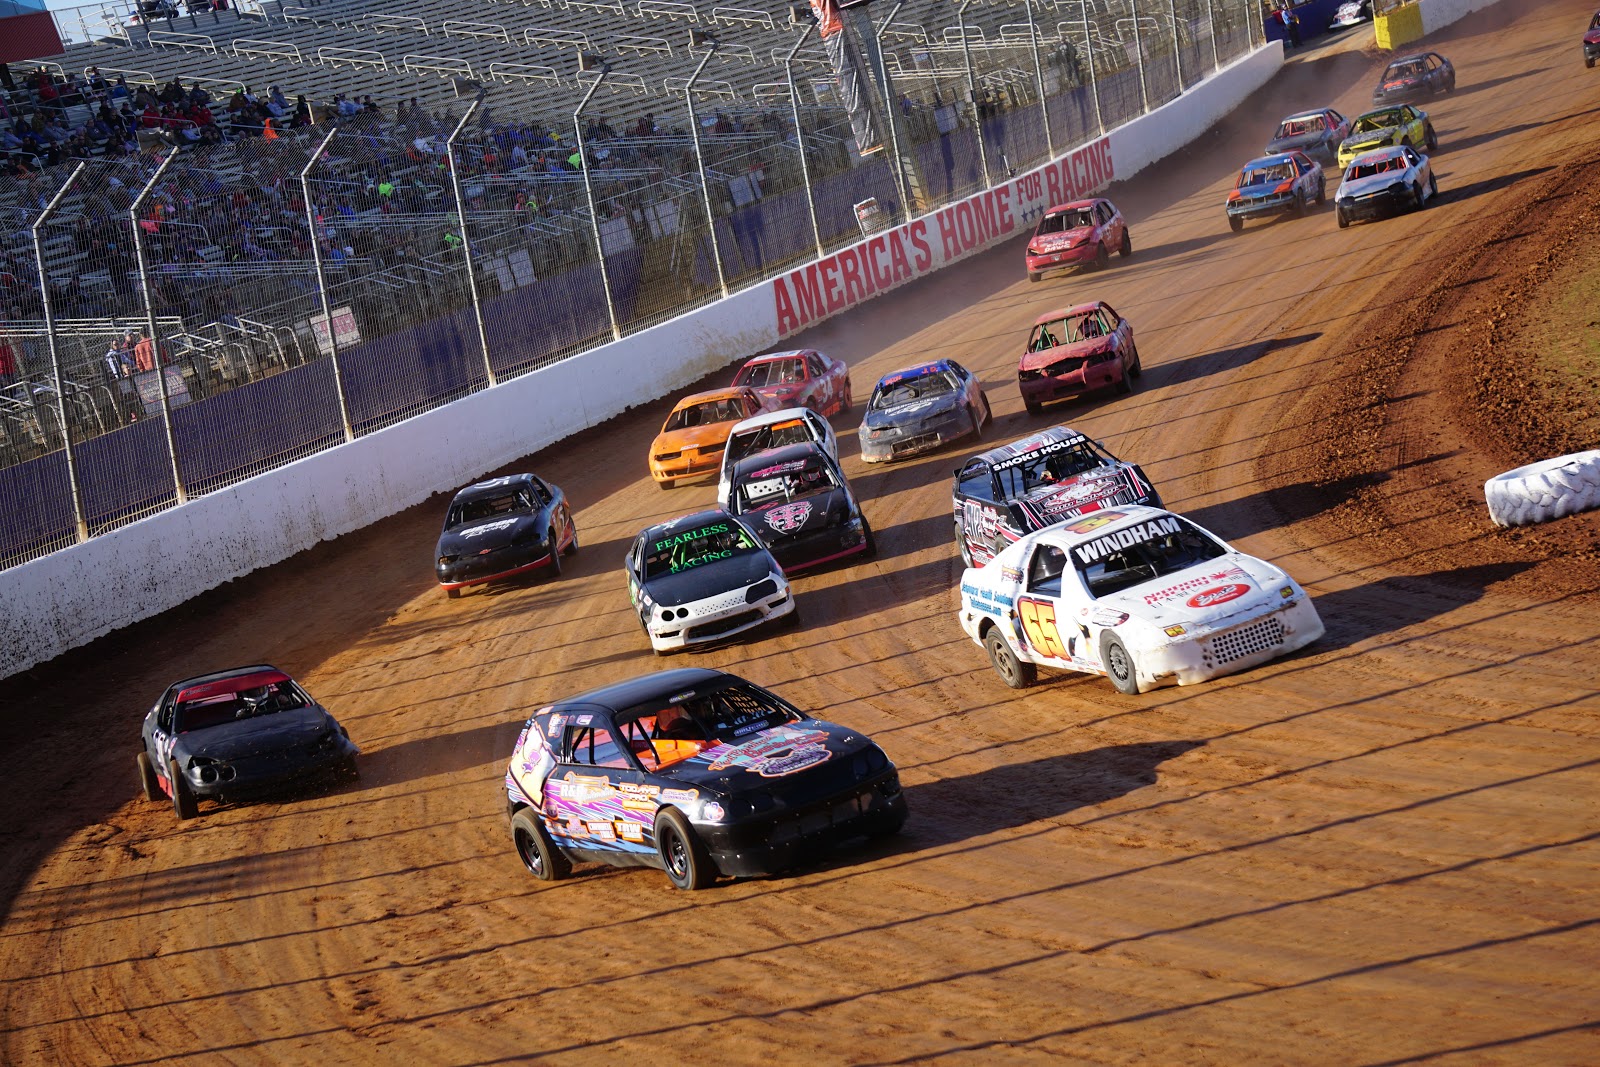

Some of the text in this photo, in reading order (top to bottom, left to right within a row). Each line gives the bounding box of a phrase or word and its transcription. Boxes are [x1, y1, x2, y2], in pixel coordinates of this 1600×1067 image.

[773, 137, 1114, 337] AMERICA'S HOME FOR RACING
[993, 434, 1086, 472] SMOKE HOUSE
[655, 523, 729, 551] FEARLESS
[1077, 516, 1182, 564] WINDHAM
[670, 550, 732, 574] RACING
[1017, 595, 1073, 662] 65
